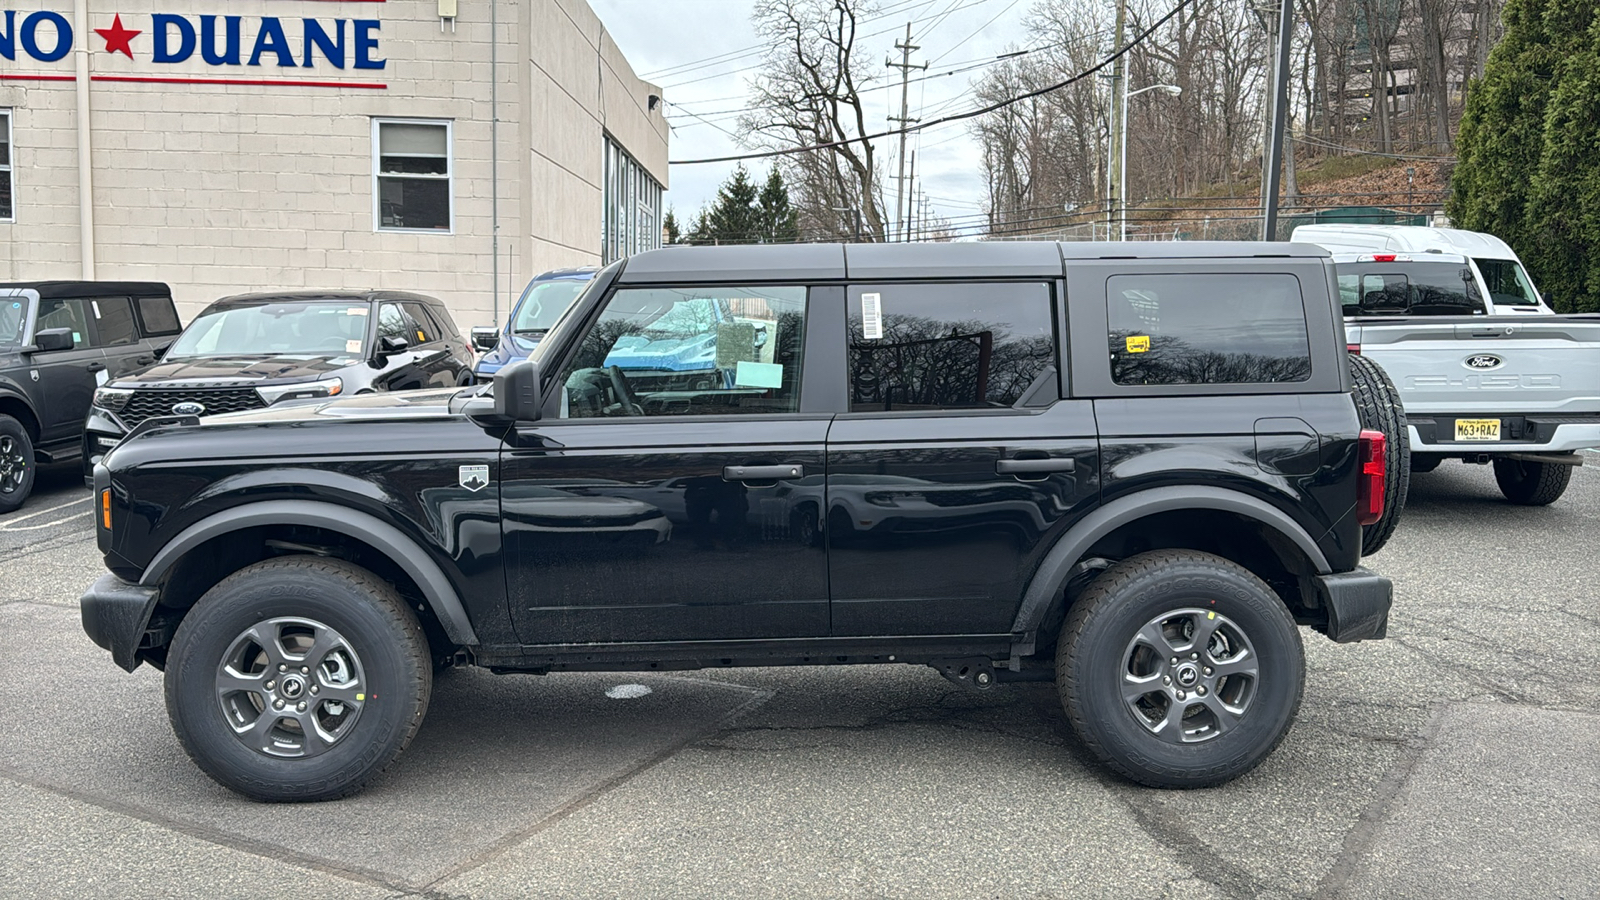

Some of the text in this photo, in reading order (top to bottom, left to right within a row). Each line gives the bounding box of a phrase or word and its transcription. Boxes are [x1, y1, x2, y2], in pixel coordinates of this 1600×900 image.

[151, 13, 387, 70] DUANE
[1472, 357, 1495, 367] Ford
[1404, 374, 1561, 389] F-150
